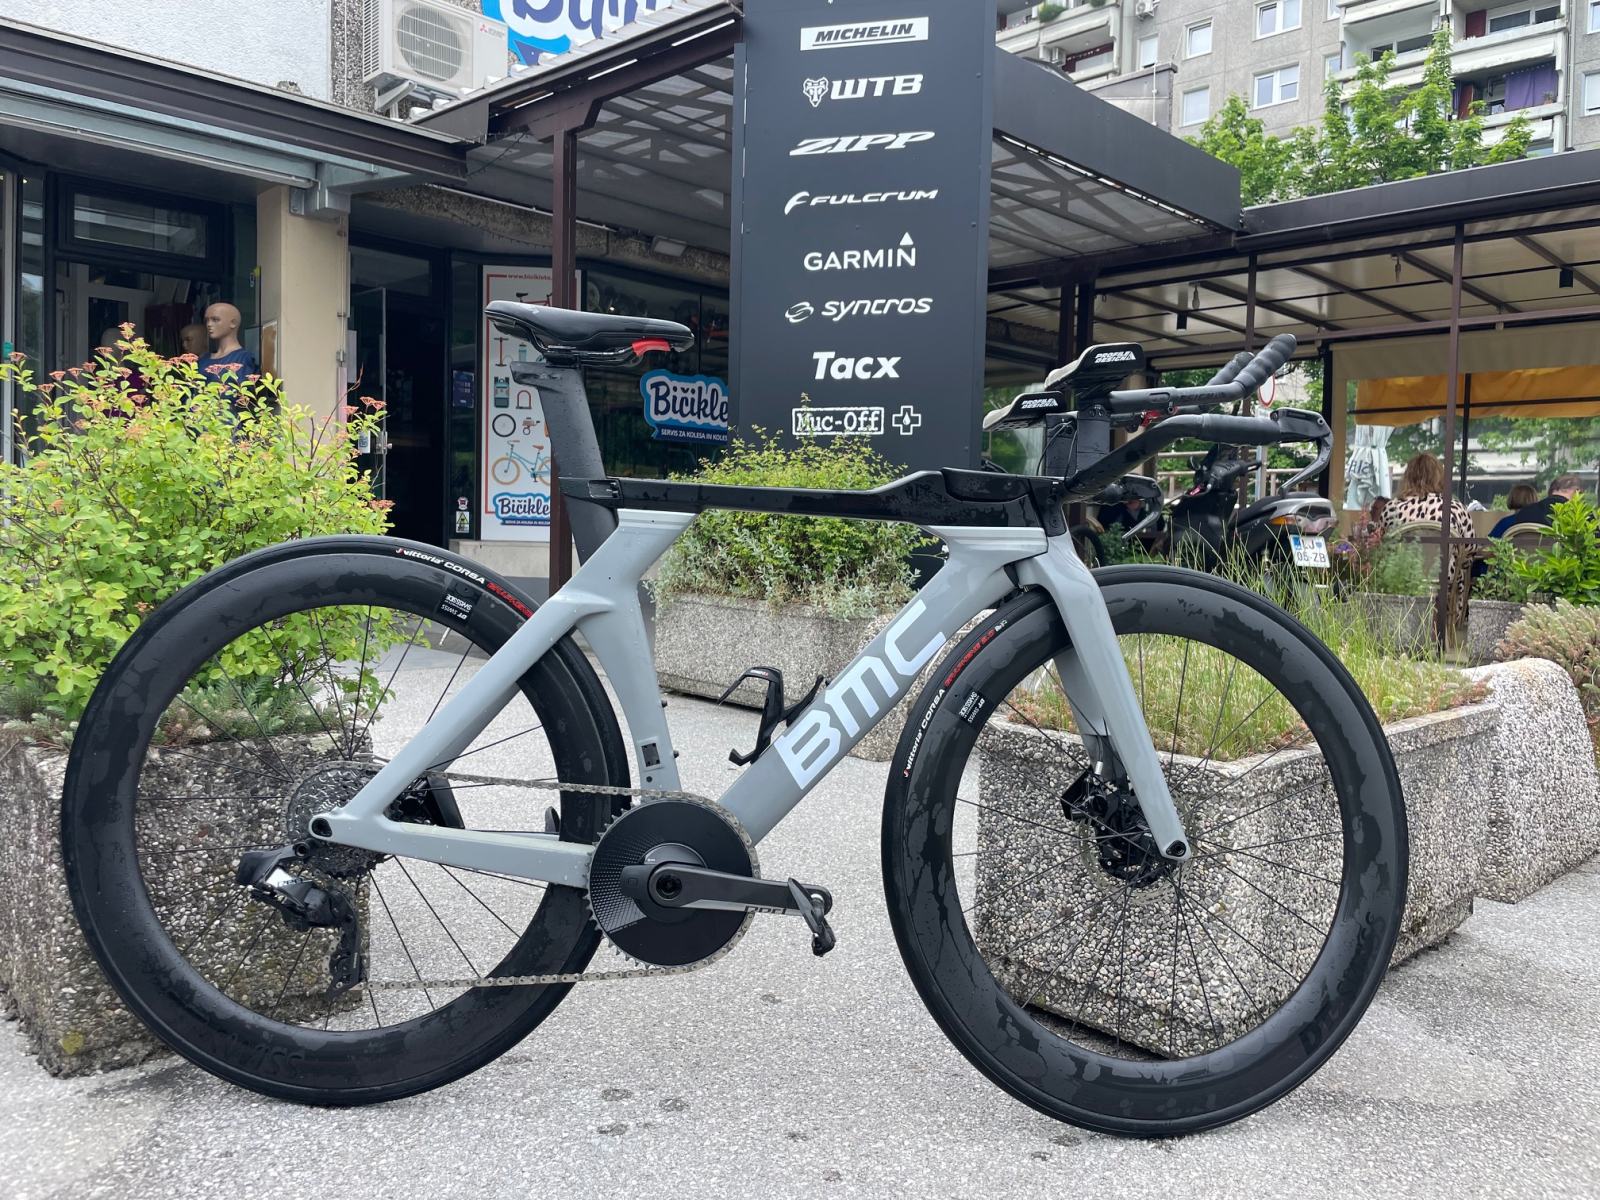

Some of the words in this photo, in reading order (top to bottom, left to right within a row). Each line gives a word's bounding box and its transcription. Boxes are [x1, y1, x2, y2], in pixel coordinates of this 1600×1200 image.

[815, 23, 914, 43] MICHELIN
[831, 74, 923, 100] WTB
[789, 131, 935, 156] ZIPP
[810, 189, 938, 207] FULCRUM
[803, 246, 916, 271] GARMIN
[812, 351, 902, 380] Tacx
[796, 411, 880, 432] Muc-Off
[444, 561, 486, 585] CORSA
[773, 599, 947, 790] BMC
[921, 688, 945, 729] CORSA
